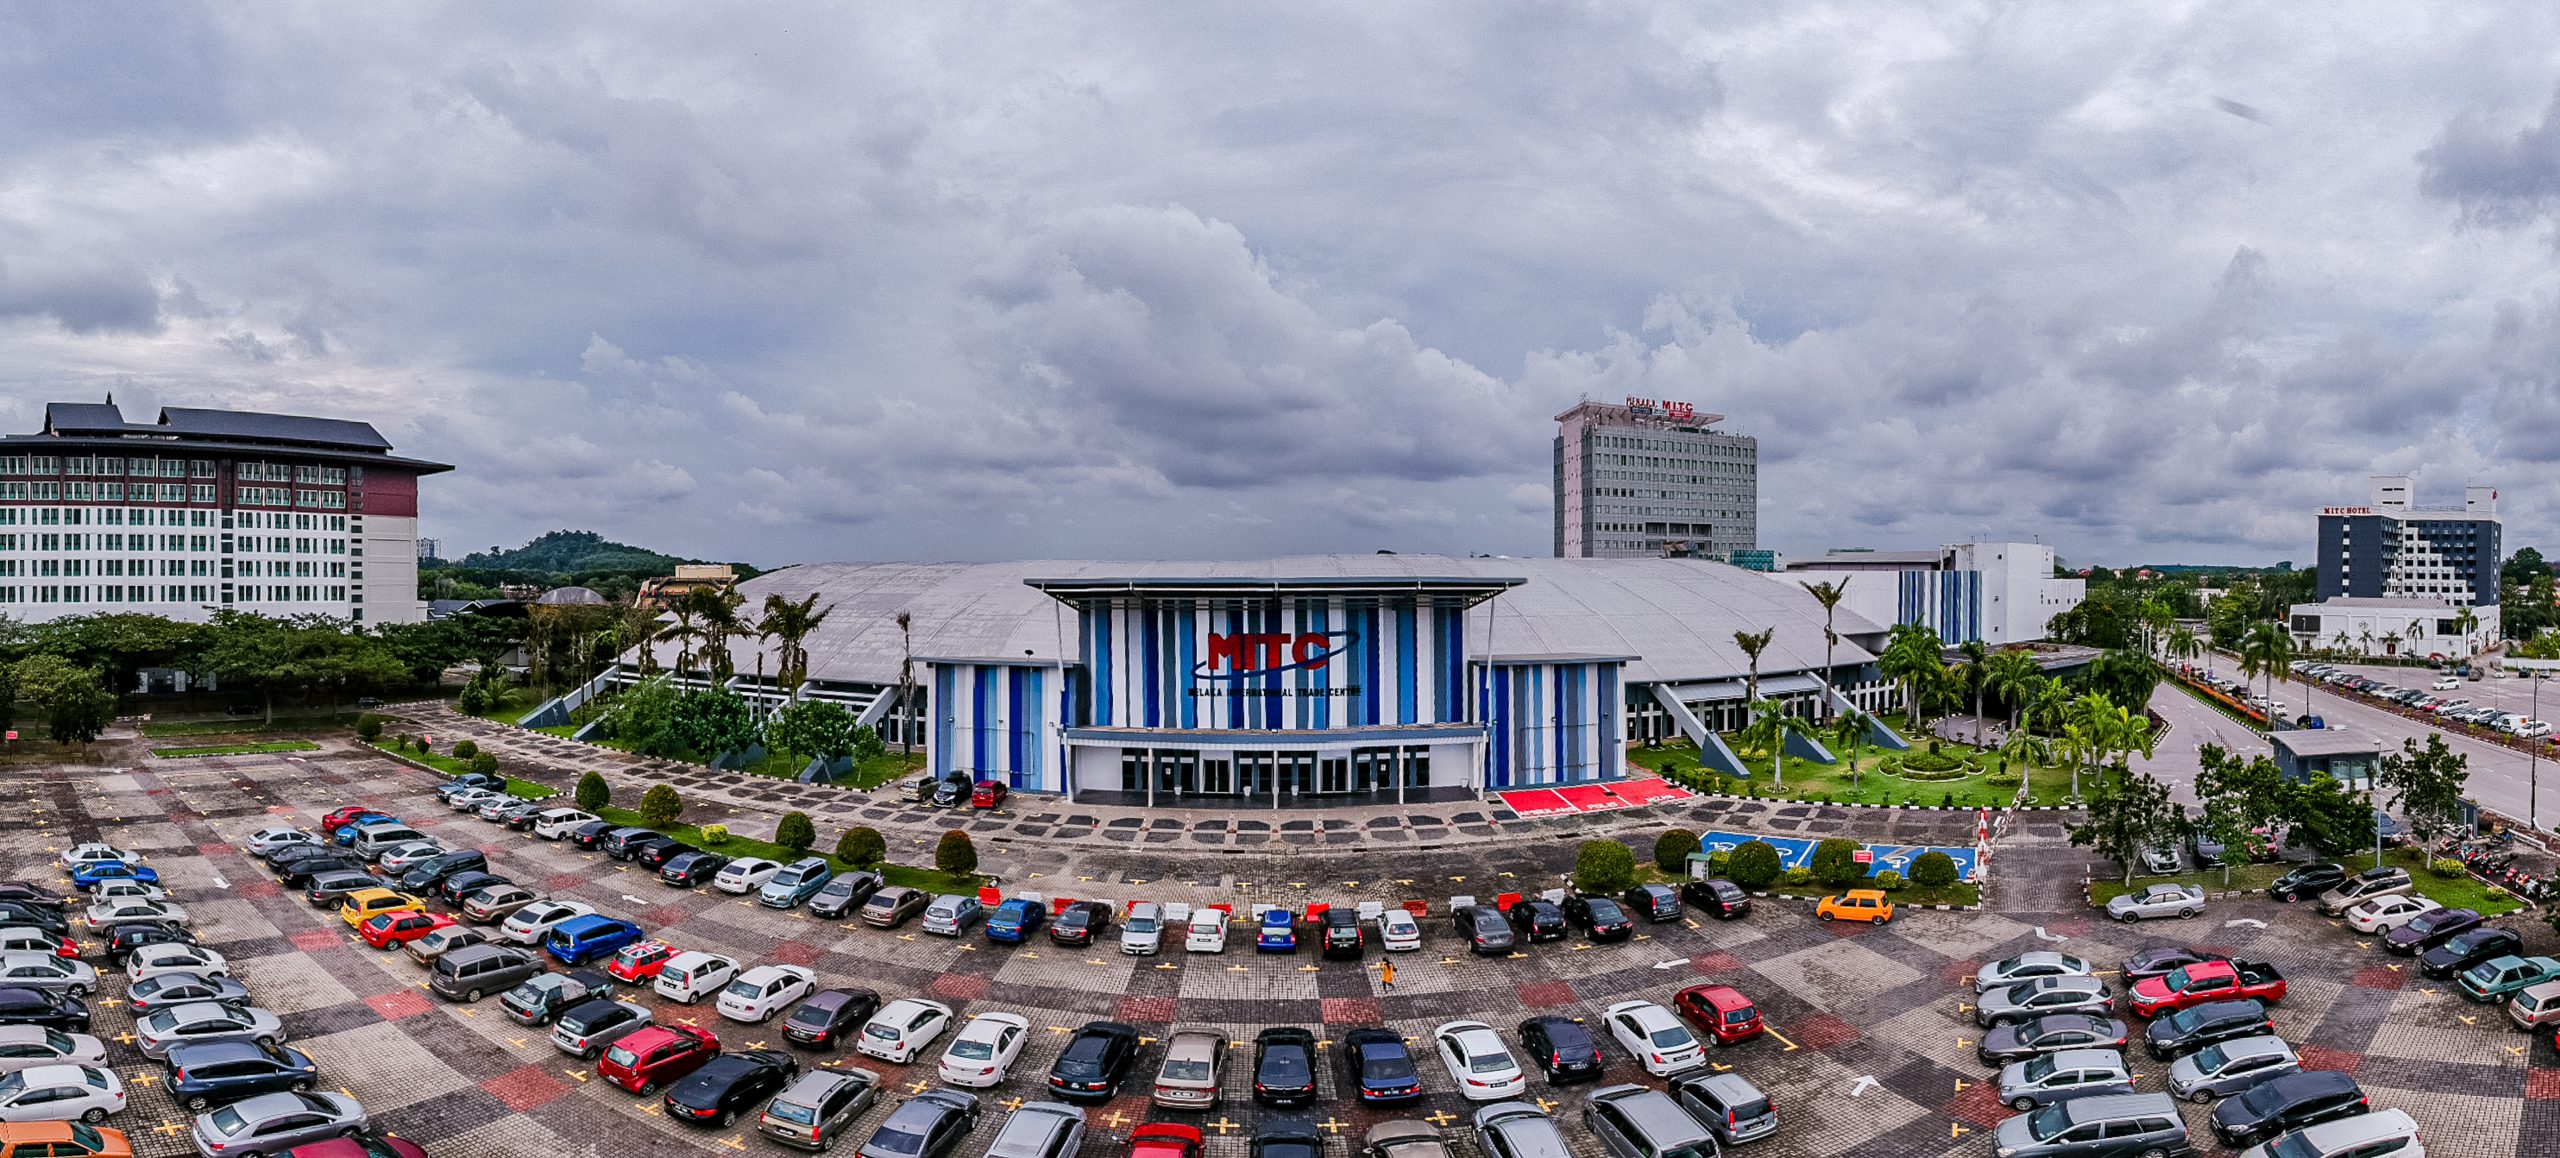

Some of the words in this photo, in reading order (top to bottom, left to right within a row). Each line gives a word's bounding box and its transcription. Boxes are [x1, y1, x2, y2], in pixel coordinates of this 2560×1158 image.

[1208, 633, 1330, 671] MITC
[1188, 687, 1223, 697] MELAKA
[1227, 687, 1292, 697] IERNATAL
[1296, 688, 1325, 697] TRADE
[1329, 686, 1361, 697] CENTRE
